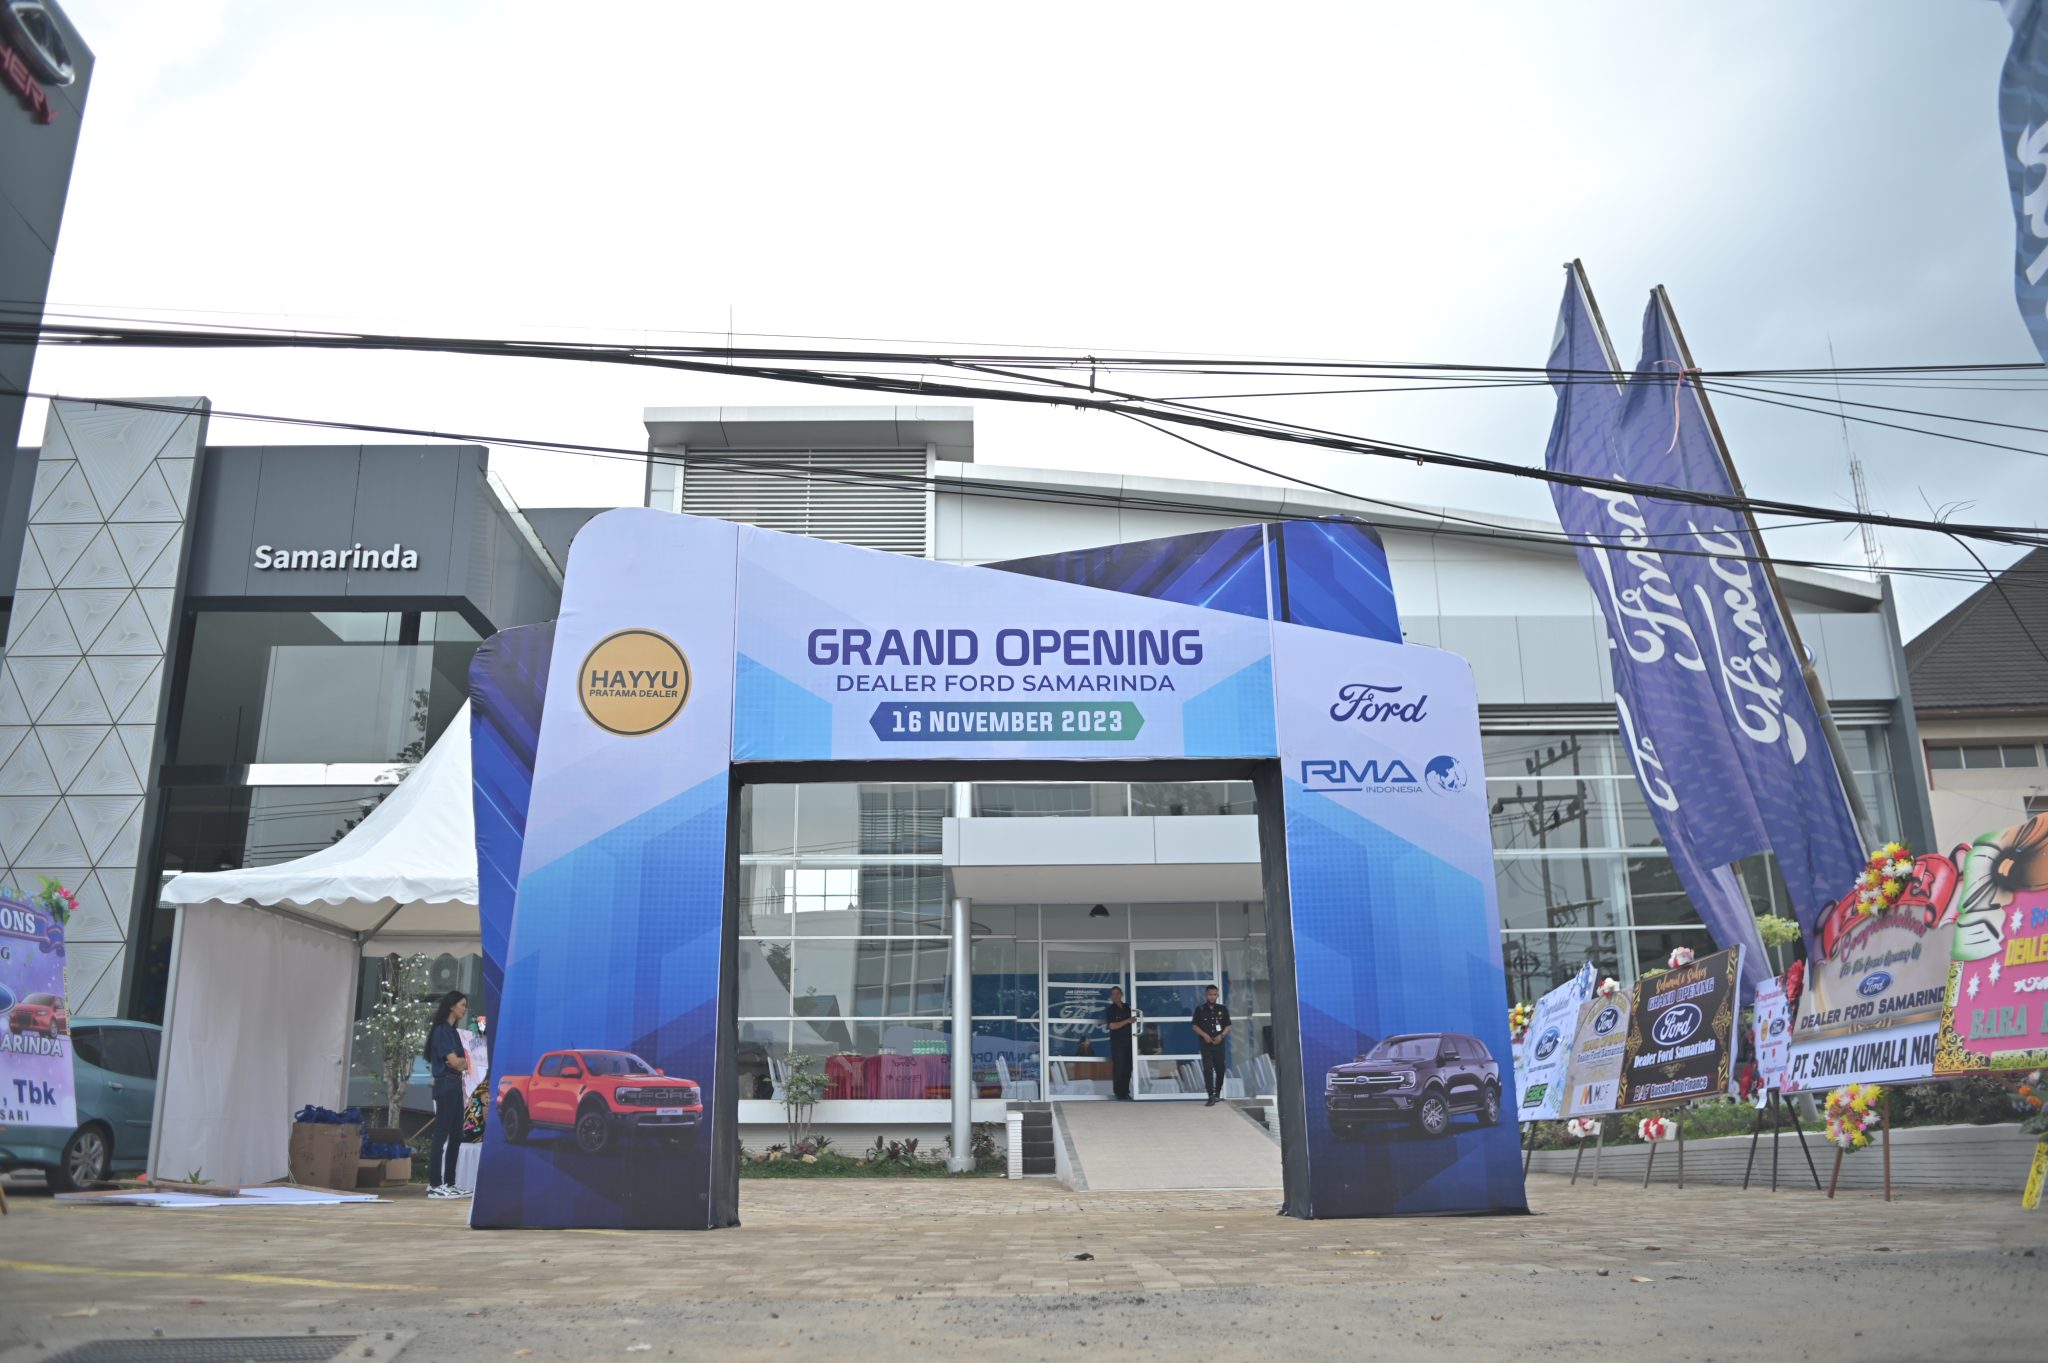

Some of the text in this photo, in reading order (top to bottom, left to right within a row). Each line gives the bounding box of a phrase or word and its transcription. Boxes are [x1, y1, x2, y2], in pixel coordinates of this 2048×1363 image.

[254, 543, 418, 570] Samarinda
[807, 628, 1204, 667] GRAND OPENING
[1688, 518, 1807, 765] Ford
[591, 670, 679, 689] HAYYU
[837, 675, 1175, 692] DEALER FORD SAMARINDA
[589, 689, 678, 698] PRATAMA DEALER
[1330, 684, 1428, 722] Ford
[892, 711, 1122, 732] 16 NOVEMBER 2023
[1301, 760, 1418, 784] RMA
[0, 908, 36, 935] ONS
[1863, 975, 1884, 994] Ford
[1053, 1005, 1110, 1034] For
[1597, 1010, 1616, 1033] Ford
[1660, 1009, 1691, 1040] Ford
[1801, 1009, 1841, 1030] DEALER
[1844, 1002, 1874, 1021] FORD
[1969, 1004, 2027, 1041] BARA
[0, 1033, 63, 1057] ARINDA
[1634, 1053, 1657, 1068] Dealer
[1657, 1047, 1674, 1064] Ford
[1675, 1039, 1716, 1060] Samarinda
[1791, 1053, 1808, 1080] PT.
[1811, 1047, 1849, 1078] SINAR
[1850, 1038, 1907, 1073] KUMALA
[13, 1079, 56, 1106] Tbk
